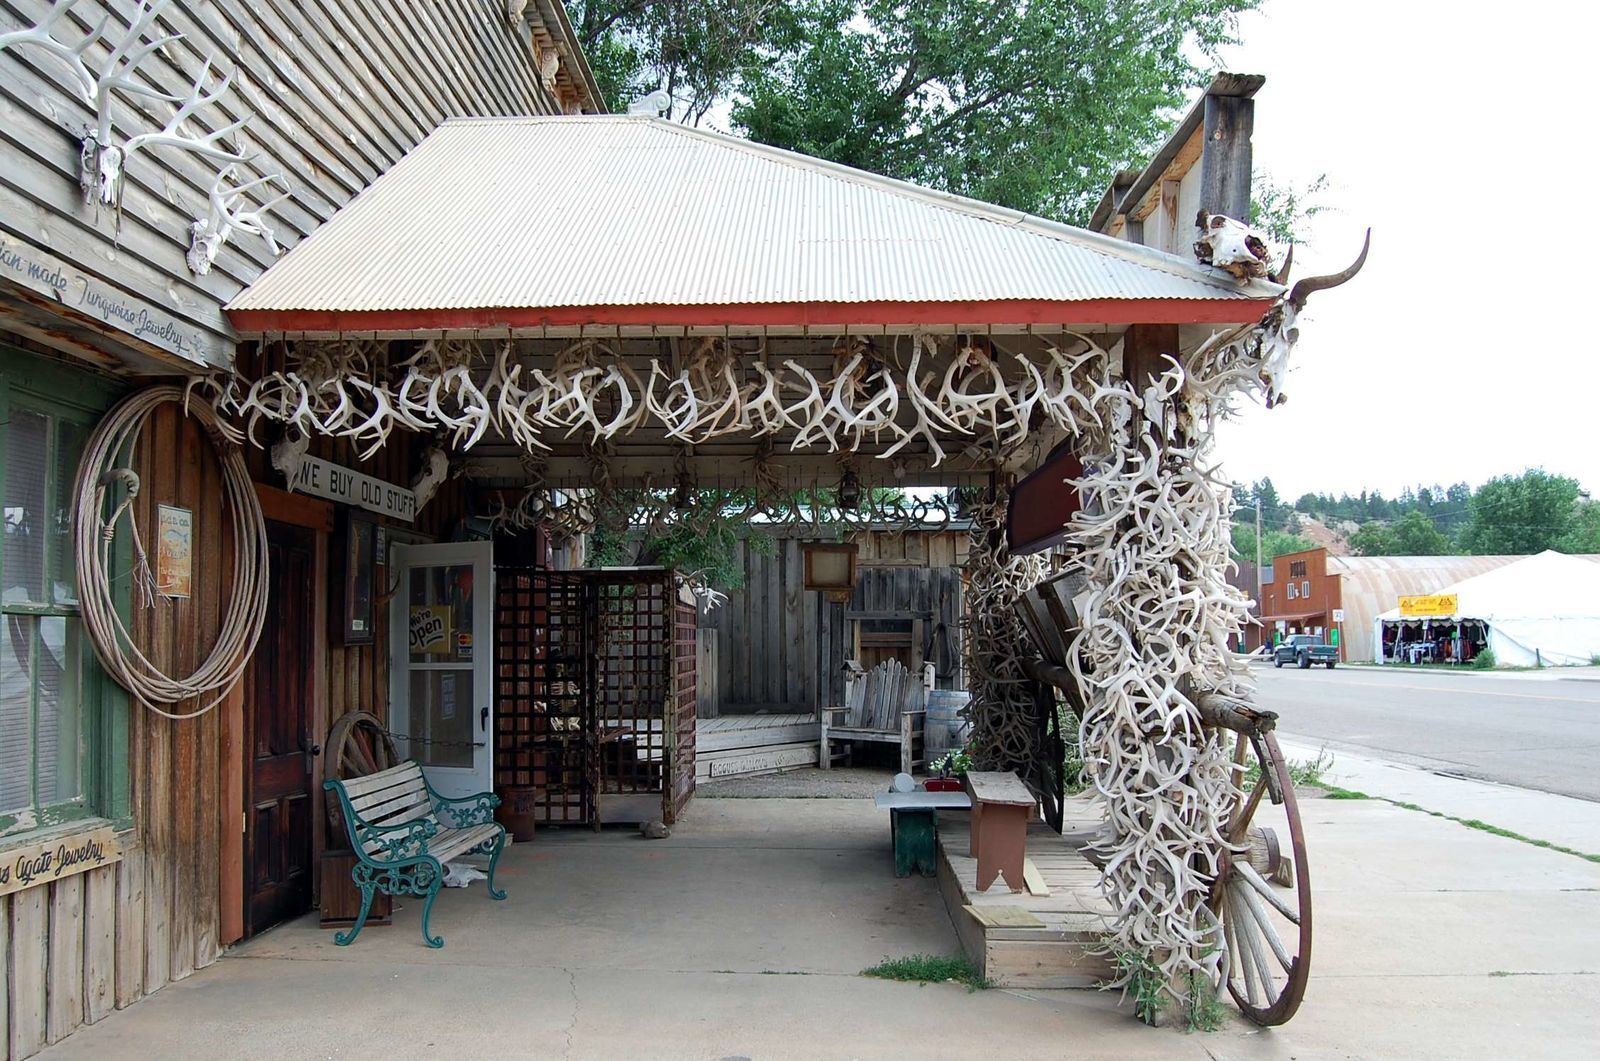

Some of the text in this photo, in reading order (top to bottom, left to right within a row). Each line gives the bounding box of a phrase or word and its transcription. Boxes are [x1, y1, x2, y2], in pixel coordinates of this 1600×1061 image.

[28, 262, 67, 291] made
[75, 275, 135, 325] Turquoise
[134, 309, 189, 352] Jewelry
[330, 470, 353, 497] BUY
[361, 481, 381, 506] OLD
[387, 490, 413, 515] STUFF
[410, 618, 442, 647] Open
[16, 851, 52, 886] Agate
[55, 839, 105, 876] Jewelry
